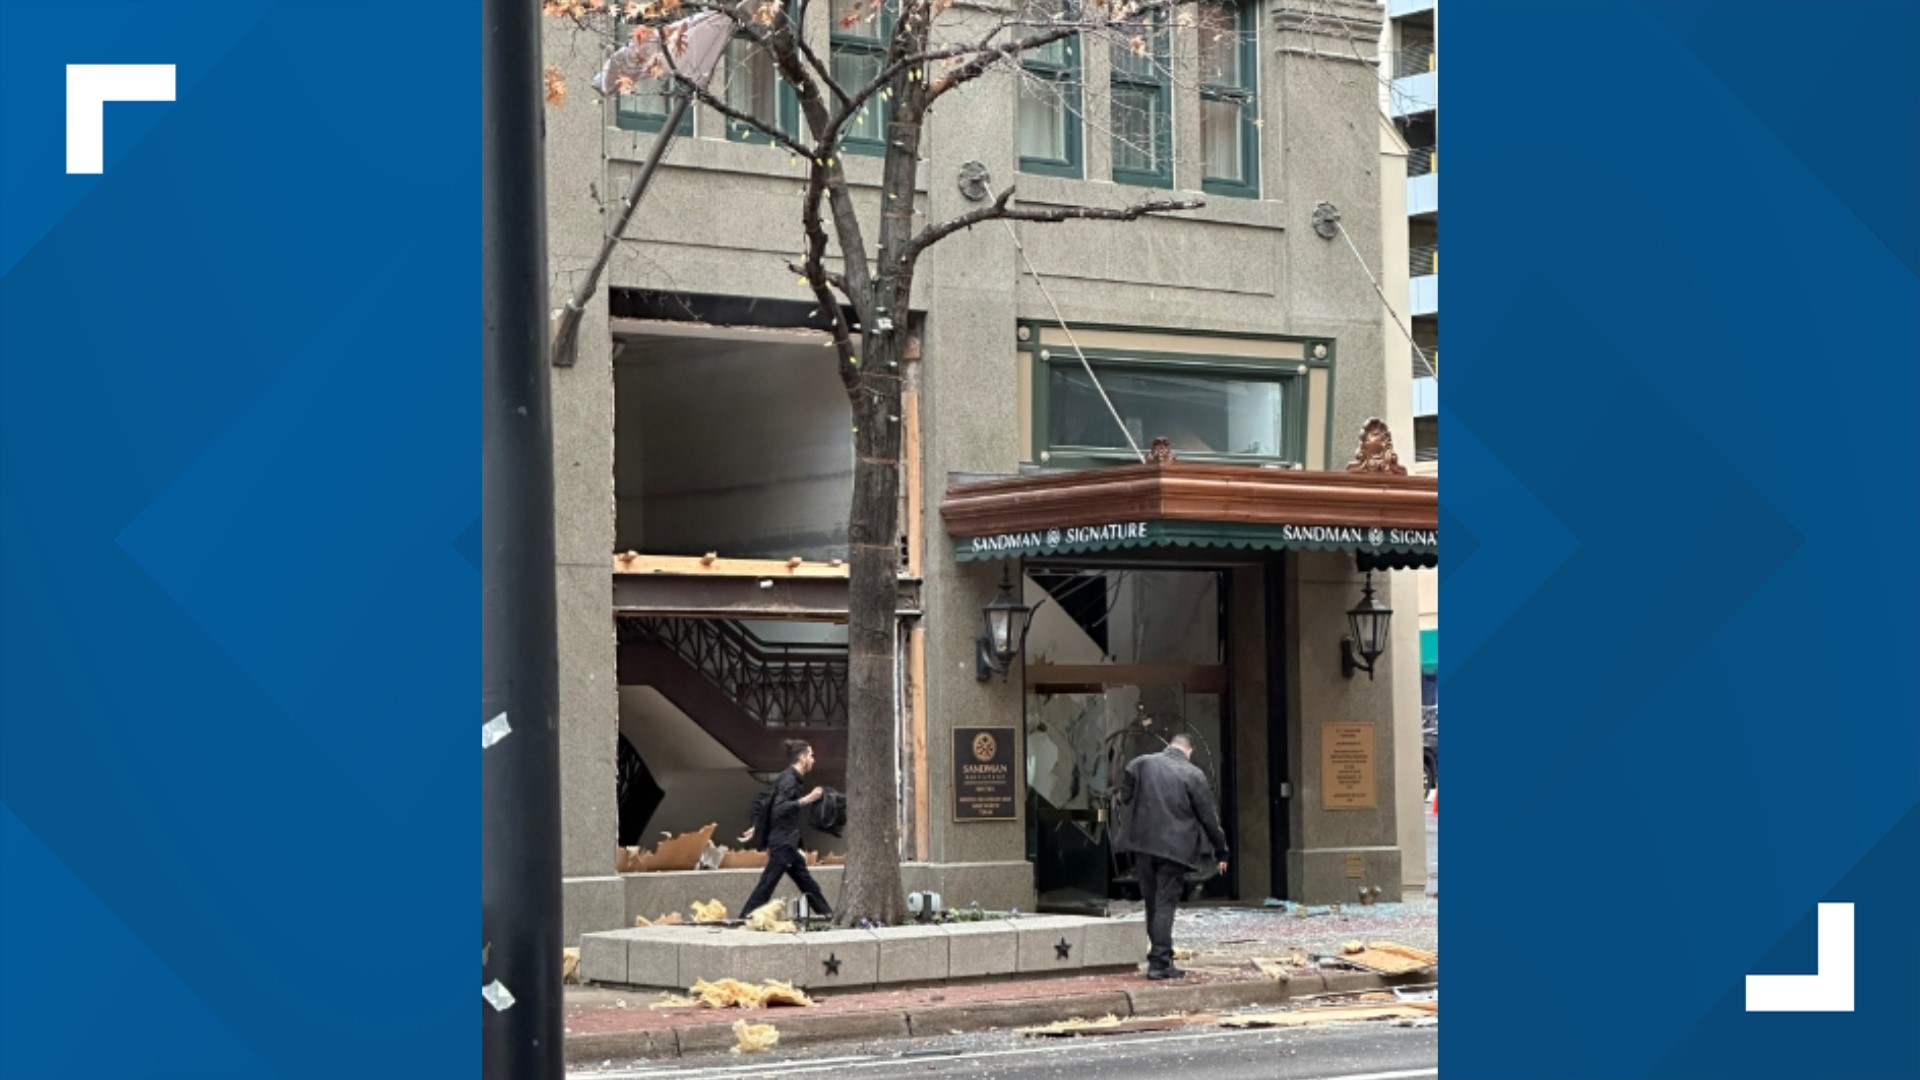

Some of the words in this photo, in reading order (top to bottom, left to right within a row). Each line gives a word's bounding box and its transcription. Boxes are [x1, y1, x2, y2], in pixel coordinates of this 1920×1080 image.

[972, 531, 1042, 552] SANDMAN
[1065, 522, 1147, 544] SIGNATURE
[1283, 524, 1362, 542] SANDMAN
[1390, 529, 1438, 546] SIGNA
[963, 764, 1008, 774] SANDMAN
